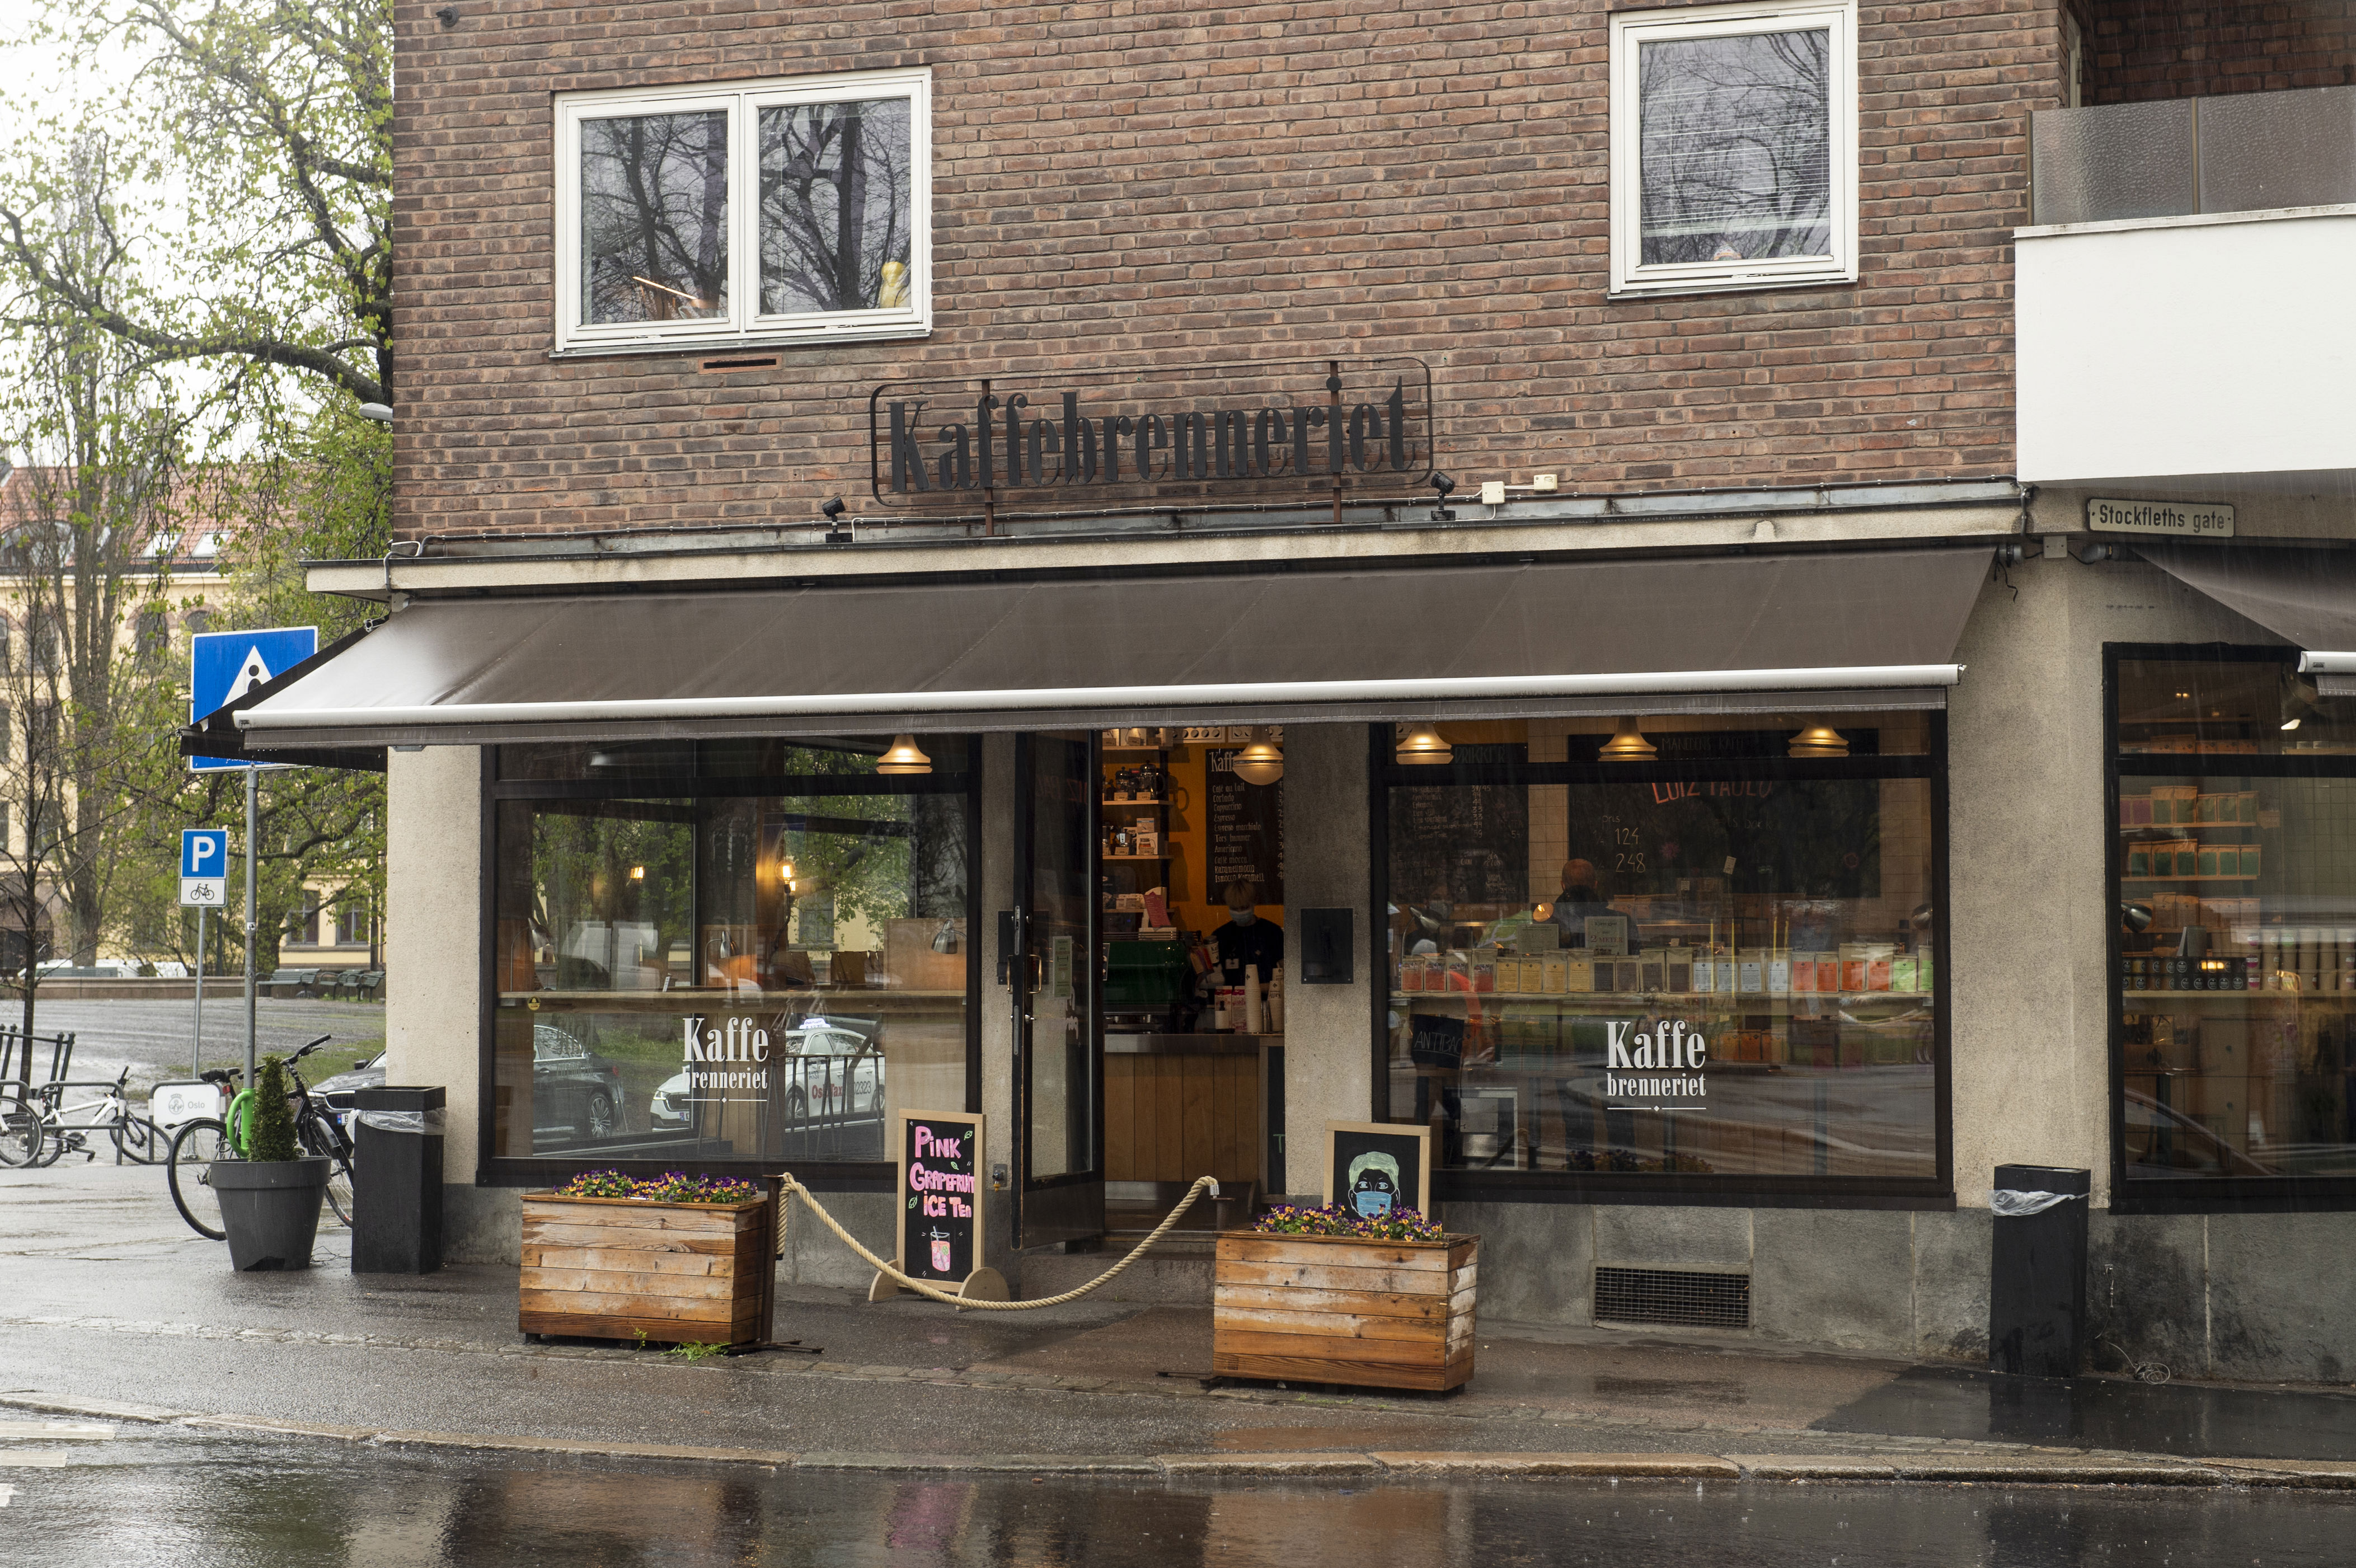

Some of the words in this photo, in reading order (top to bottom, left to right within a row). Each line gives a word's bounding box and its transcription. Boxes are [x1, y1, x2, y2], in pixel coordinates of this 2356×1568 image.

[886, 375, 1415, 492] Kaffebrenneriet
[2100, 504, 2185, 527] Stockfleths
[2193, 510, 2224, 533] gate
[1615, 827, 1640, 846] 124
[192, 836, 215, 872] P
[1616, 852, 1646, 873] 248
[683, 1017, 768, 1062] Kaffe
[1414, 1031, 1462, 1054] ANTIBAC
[1606, 1021, 1706, 1068] Kaffe
[682, 1067, 768, 1089] brenneriet
[1607, 1073, 1706, 1096] brenneriet
[187, 1101, 205, 1109] Oslo
